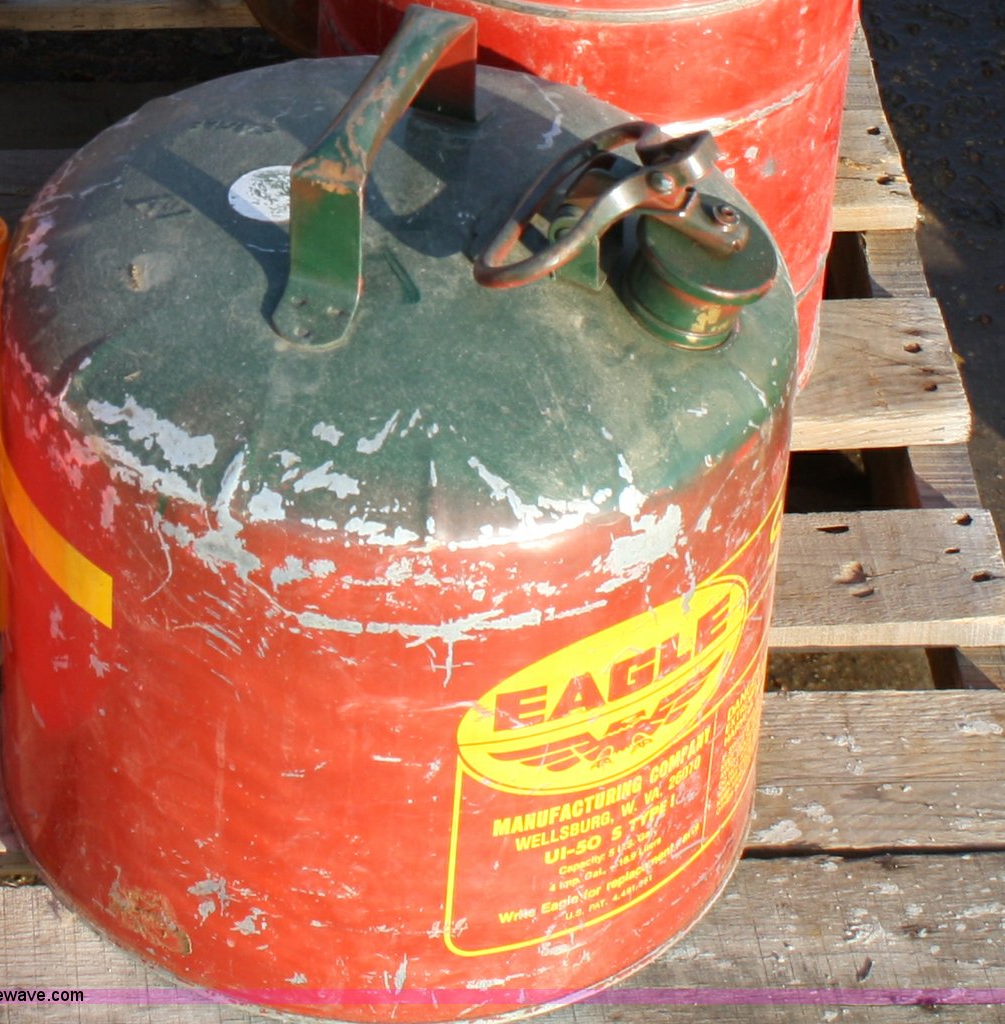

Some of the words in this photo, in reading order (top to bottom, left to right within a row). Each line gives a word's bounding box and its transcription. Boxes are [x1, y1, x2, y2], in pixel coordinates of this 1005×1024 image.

[493, 592, 732, 733] EAGLE
[492, 775, 643, 837] MANUFACTURING
[649, 724, 712, 785] COMPANY
[515, 810, 614, 852] WELLSBURG,
[621, 799, 637, 817] W.
[644, 786, 663, 805] VA.
[668, 754, 701, 791] 26070
[544, 834, 602, 865] UI-50
[611, 825, 623, 842] S
[628, 798, 668, 832] TYPE
[558, 853, 606, 876] Capacity:
[541, 894, 580, 915] Eagle
[582, 885, 602, 901] for
